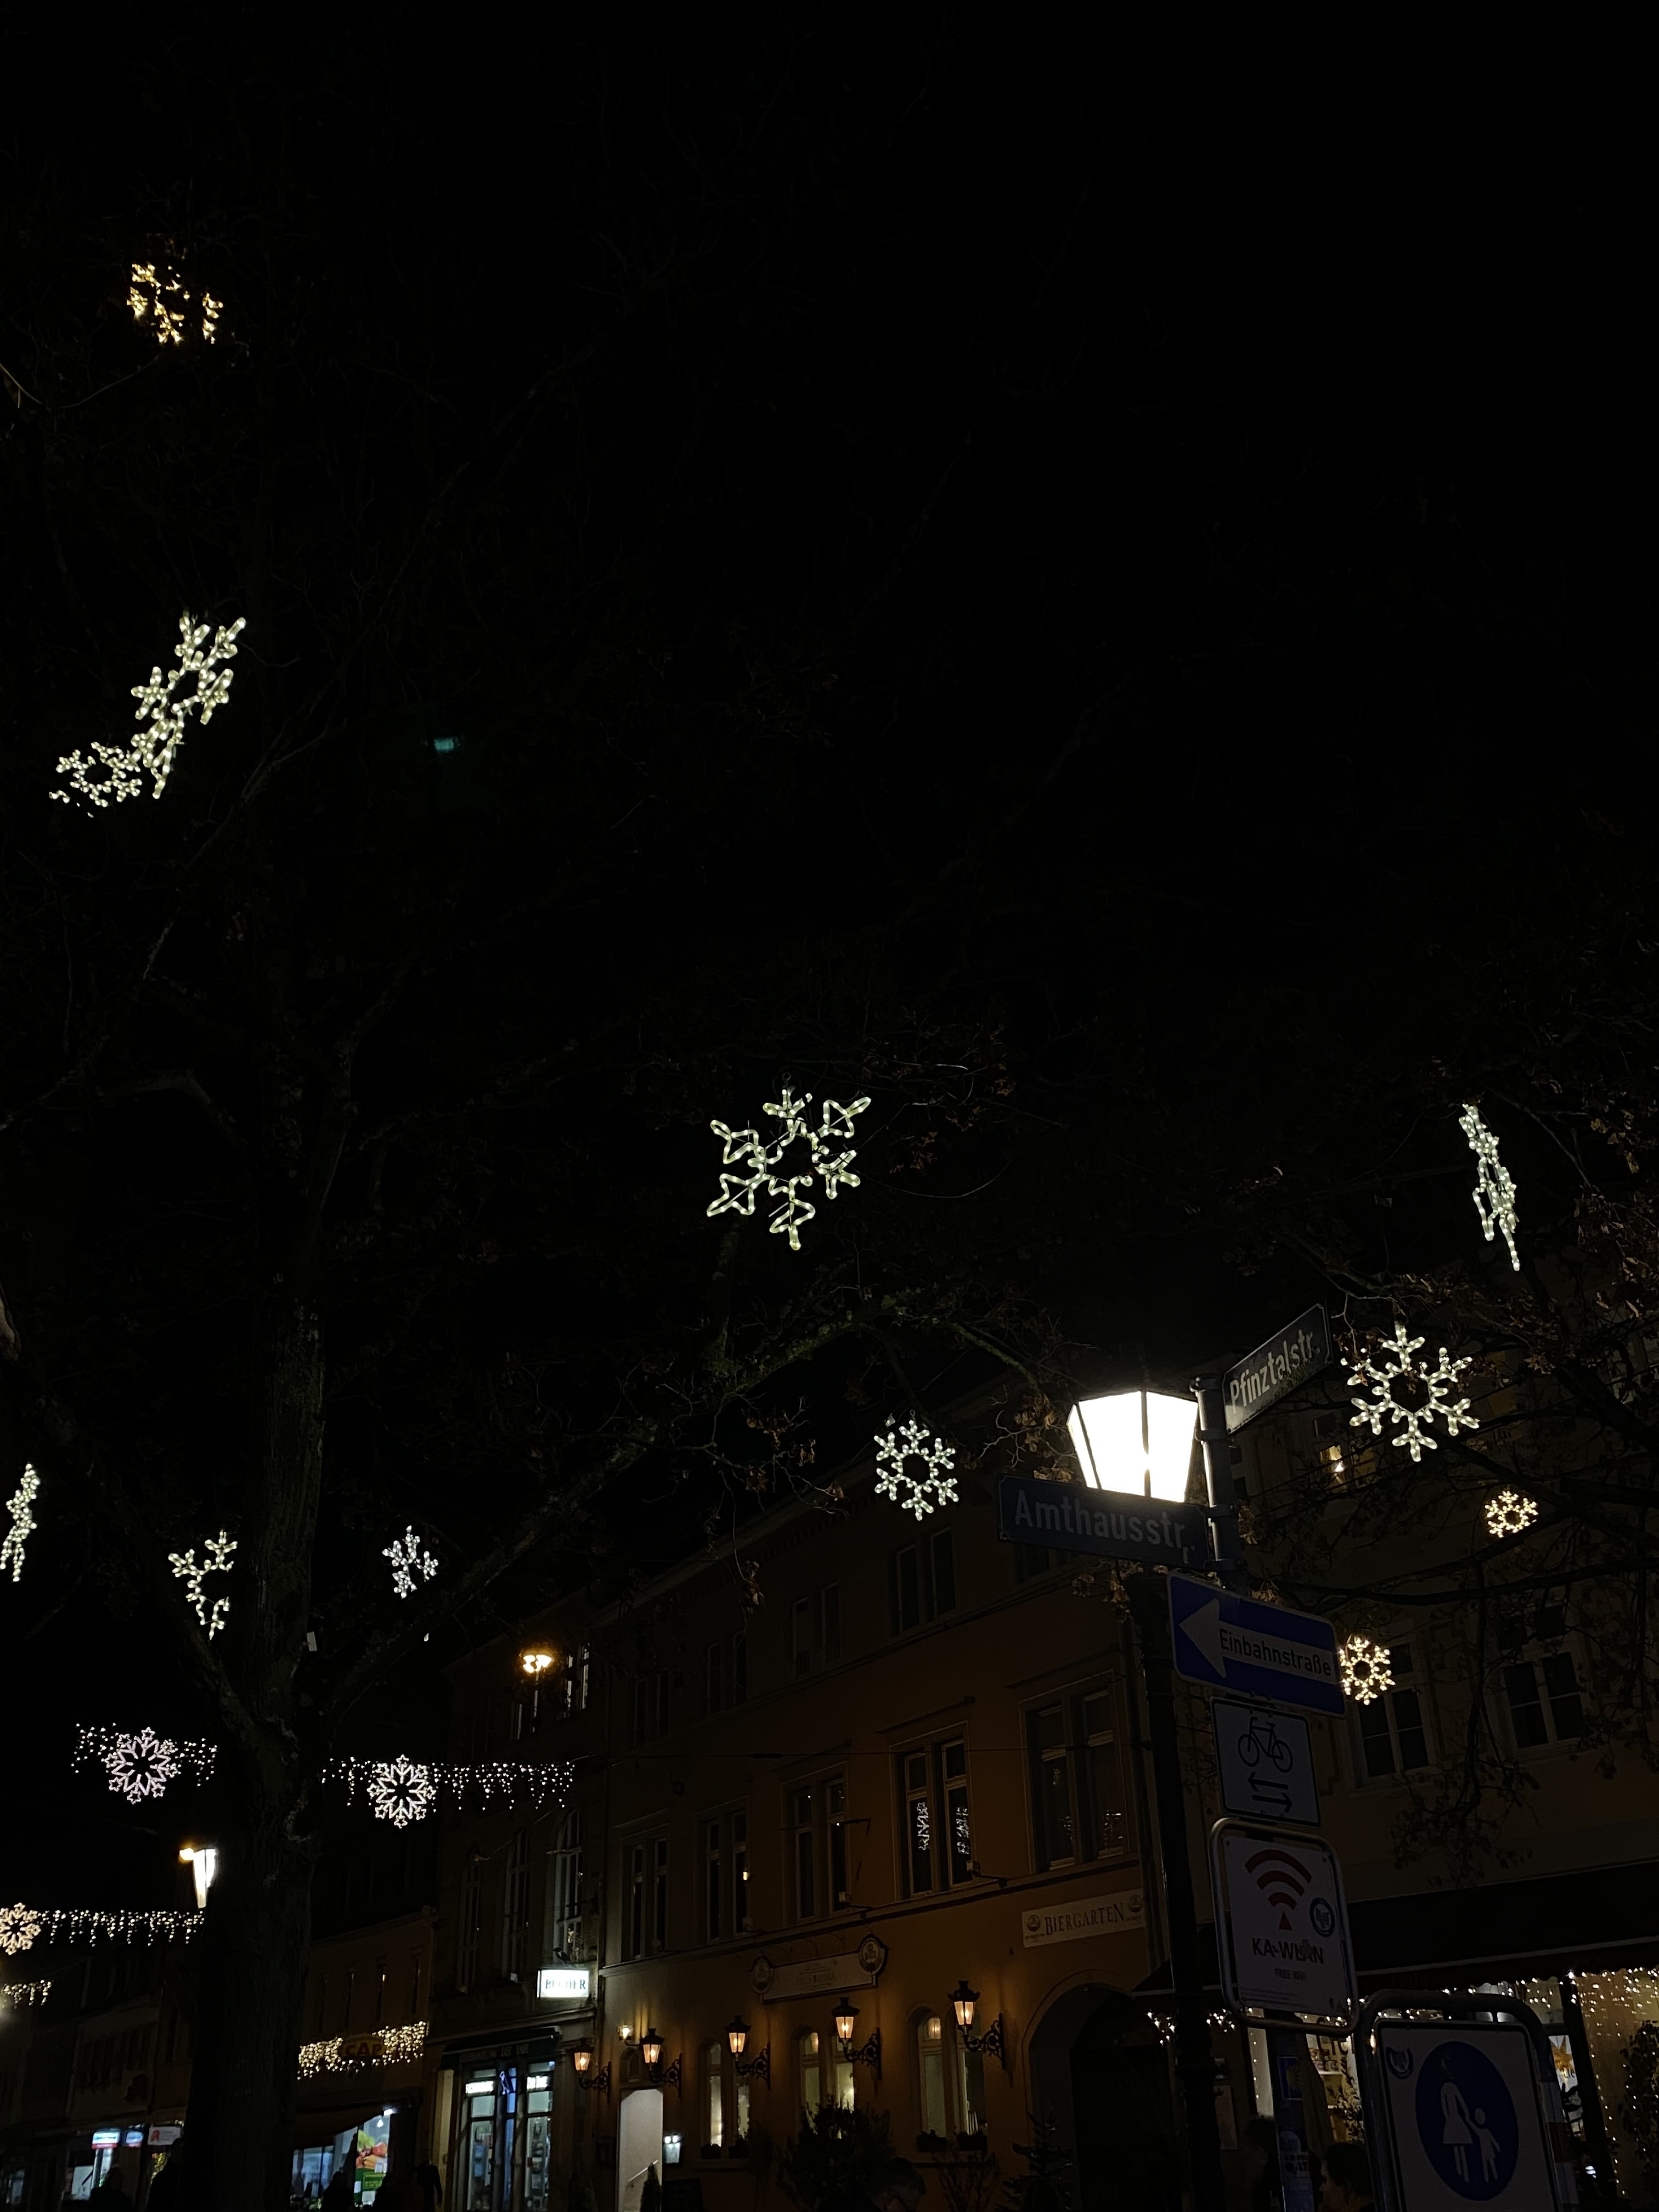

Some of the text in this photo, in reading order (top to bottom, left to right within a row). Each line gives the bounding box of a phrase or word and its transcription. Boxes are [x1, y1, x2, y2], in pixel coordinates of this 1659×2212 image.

[1228, 1328, 1321, 1413] Pfinztalstr.
[1014, 1488, 1197, 1560] Amthausstr.
[1219, 1628, 1332, 1677] Einbahnstraße
[1044, 1901, 1125, 1936] BIERGARTEN
[1252, 1937, 1324, 1965] KA-WLAN
[1274, 1967, 1291, 1979] FREE
